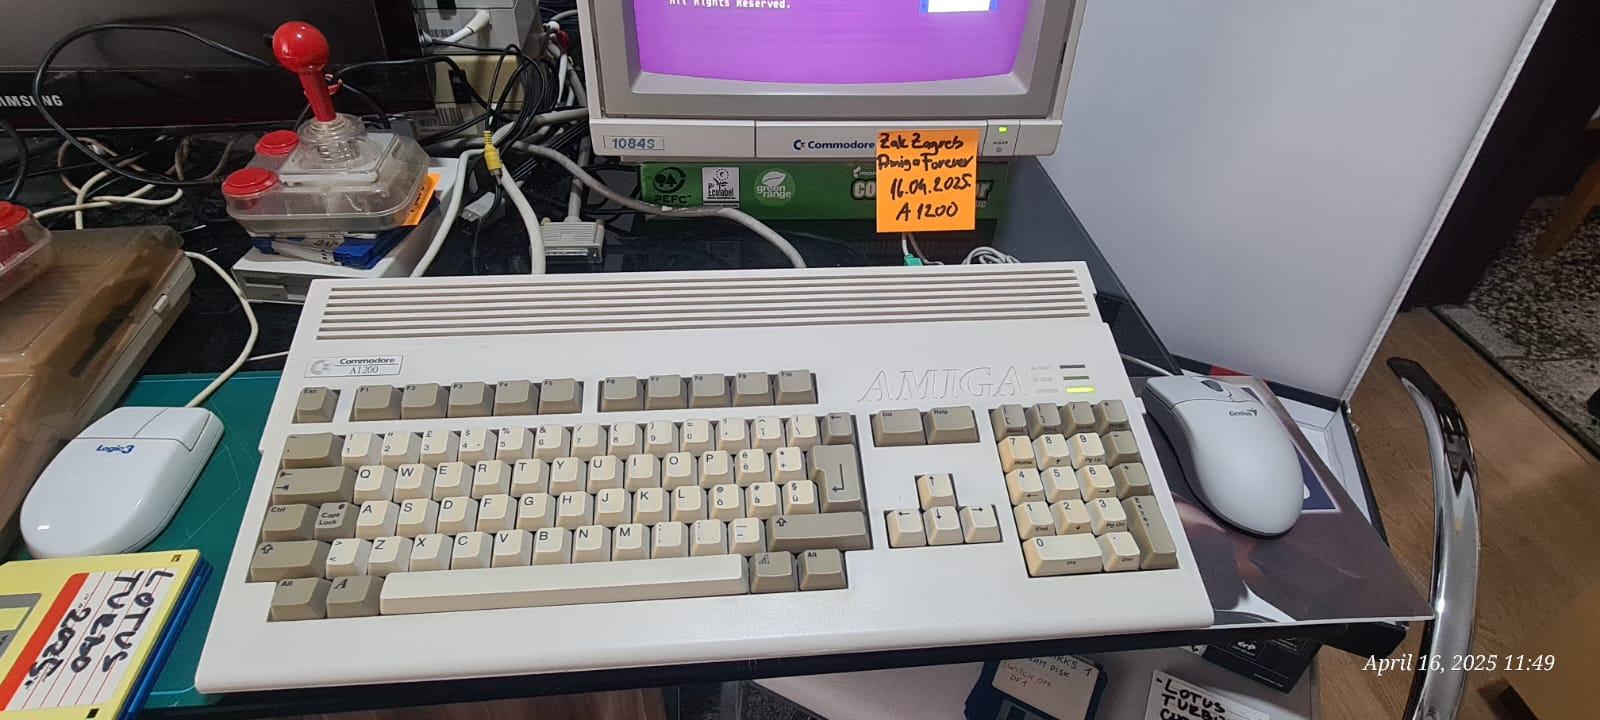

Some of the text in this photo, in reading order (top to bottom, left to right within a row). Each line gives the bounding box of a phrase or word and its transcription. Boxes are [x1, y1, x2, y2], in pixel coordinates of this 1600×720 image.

[612, 138, 656, 150] 1084S
[808, 140, 875, 150] Commodore
[876, 154, 920, 170] Amiga
[756, 185, 786, 194] green
[763, 191, 793, 200] range
[350, 366, 378, 374] A1200
[857, 365, 1027, 402] AMIGA
[557, 461, 565, 469] Y
[594, 460, 602, 468] U
[669, 457, 678, 465] O
[439, 466, 447, 474] E
[478, 464, 487, 472] R
[518, 462, 528, 471] T
[360, 470, 370, 478] Q
[401, 468, 414, 476] W
[1054, 469, 1060, 477] 5
[1089, 467, 1096, 475] 6
[524, 497, 534, 505] G
[563, 496, 572, 504] H
[602, 493, 609, 502] J
[444, 500, 453, 509] D
[484, 498, 492, 507] F
[1064, 502, 1071, 510] 2
[362, 505, 372, 513] A
[404, 503, 413, 512] S
[539, 532, 548, 540] B
[579, 529, 588, 538] N
[620, 528, 630, 536] M
[458, 536, 468, 546] C
[500, 533, 508, 542] V
[375, 540, 386, 549] Z
[416, 538, 426, 546] X
[102, 570, 174, 672] LOTUS
[1050, 665, 1070, 678] DISK
